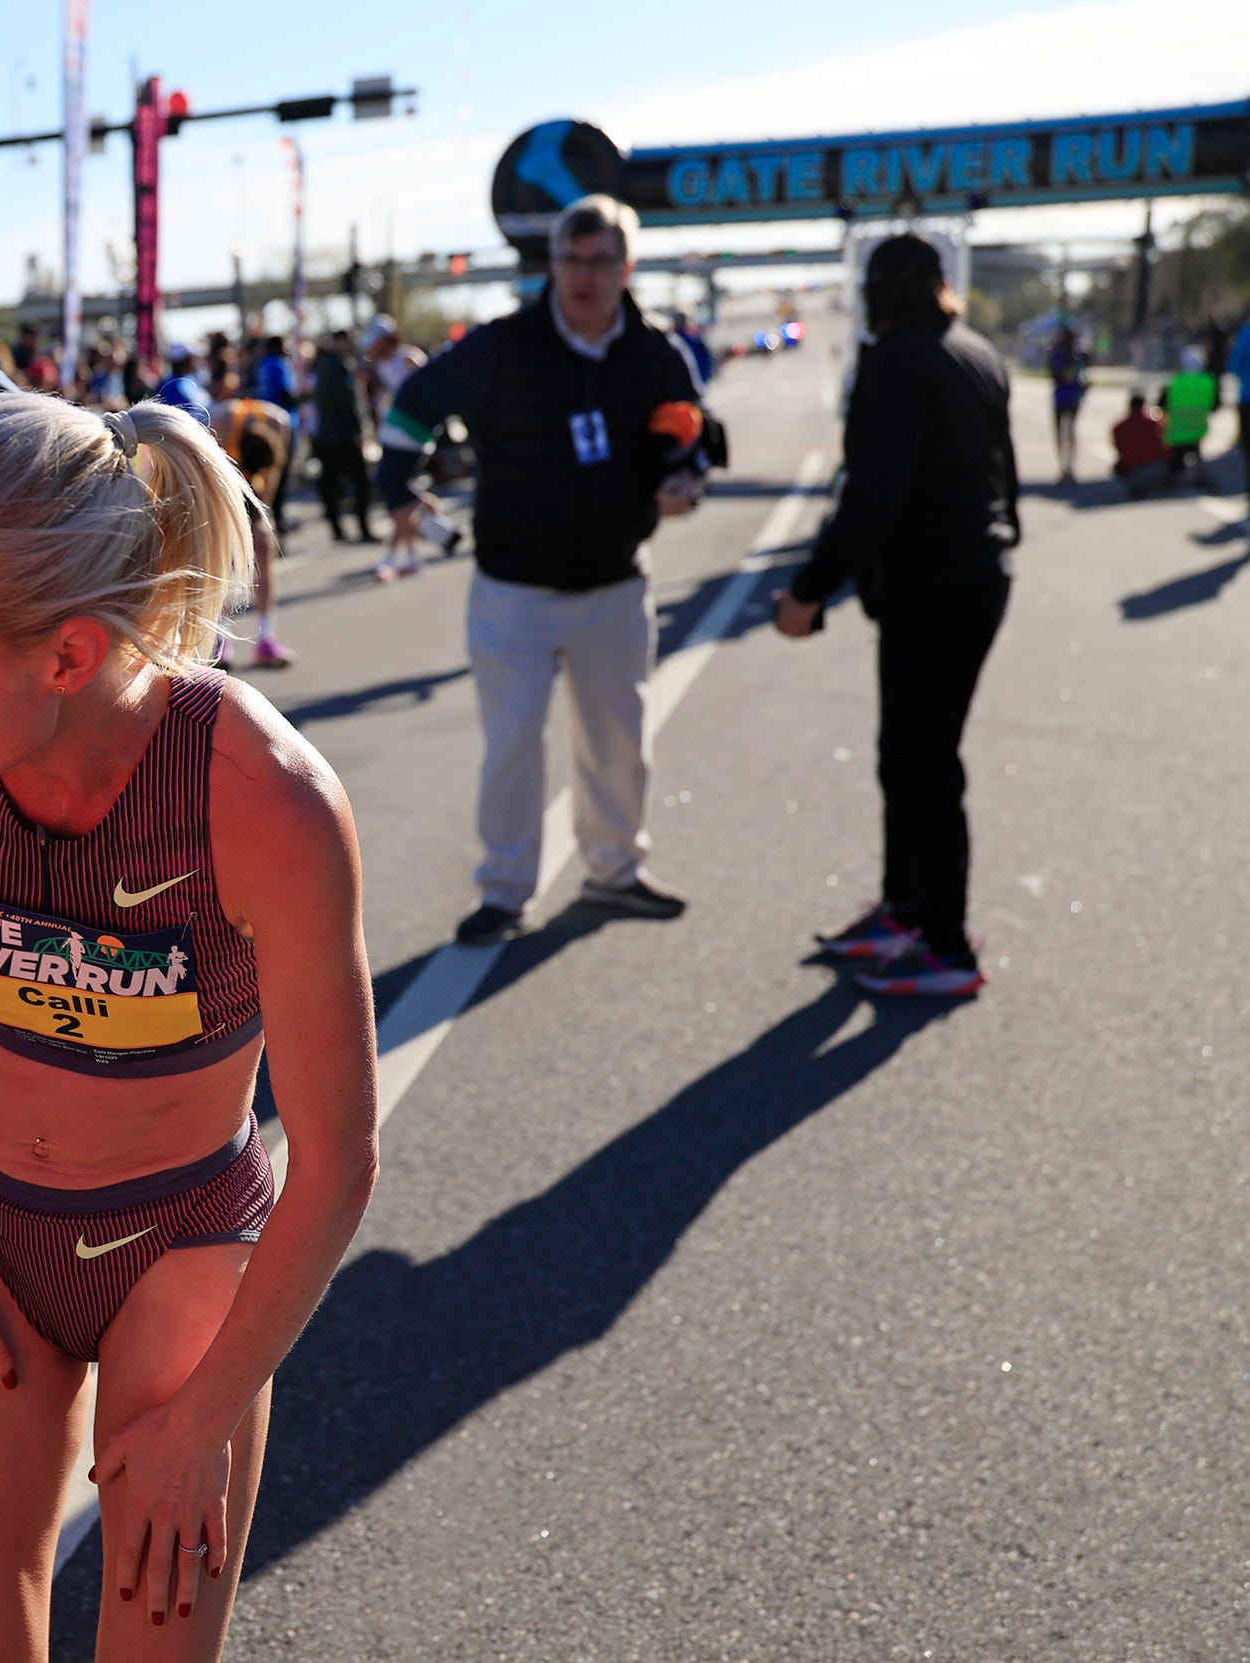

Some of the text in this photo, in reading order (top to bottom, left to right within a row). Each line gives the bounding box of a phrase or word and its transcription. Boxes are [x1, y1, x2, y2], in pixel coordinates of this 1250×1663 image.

[666, 123, 1196, 209] GATE RIVER RUN
[10, 914, 33, 925] 48TH
[33, 919, 72, 933] ANNUAL
[75, 962, 178, 997] RUN
[18, 986, 109, 1018] Calli
[52, 1013, 84, 1039] 2
